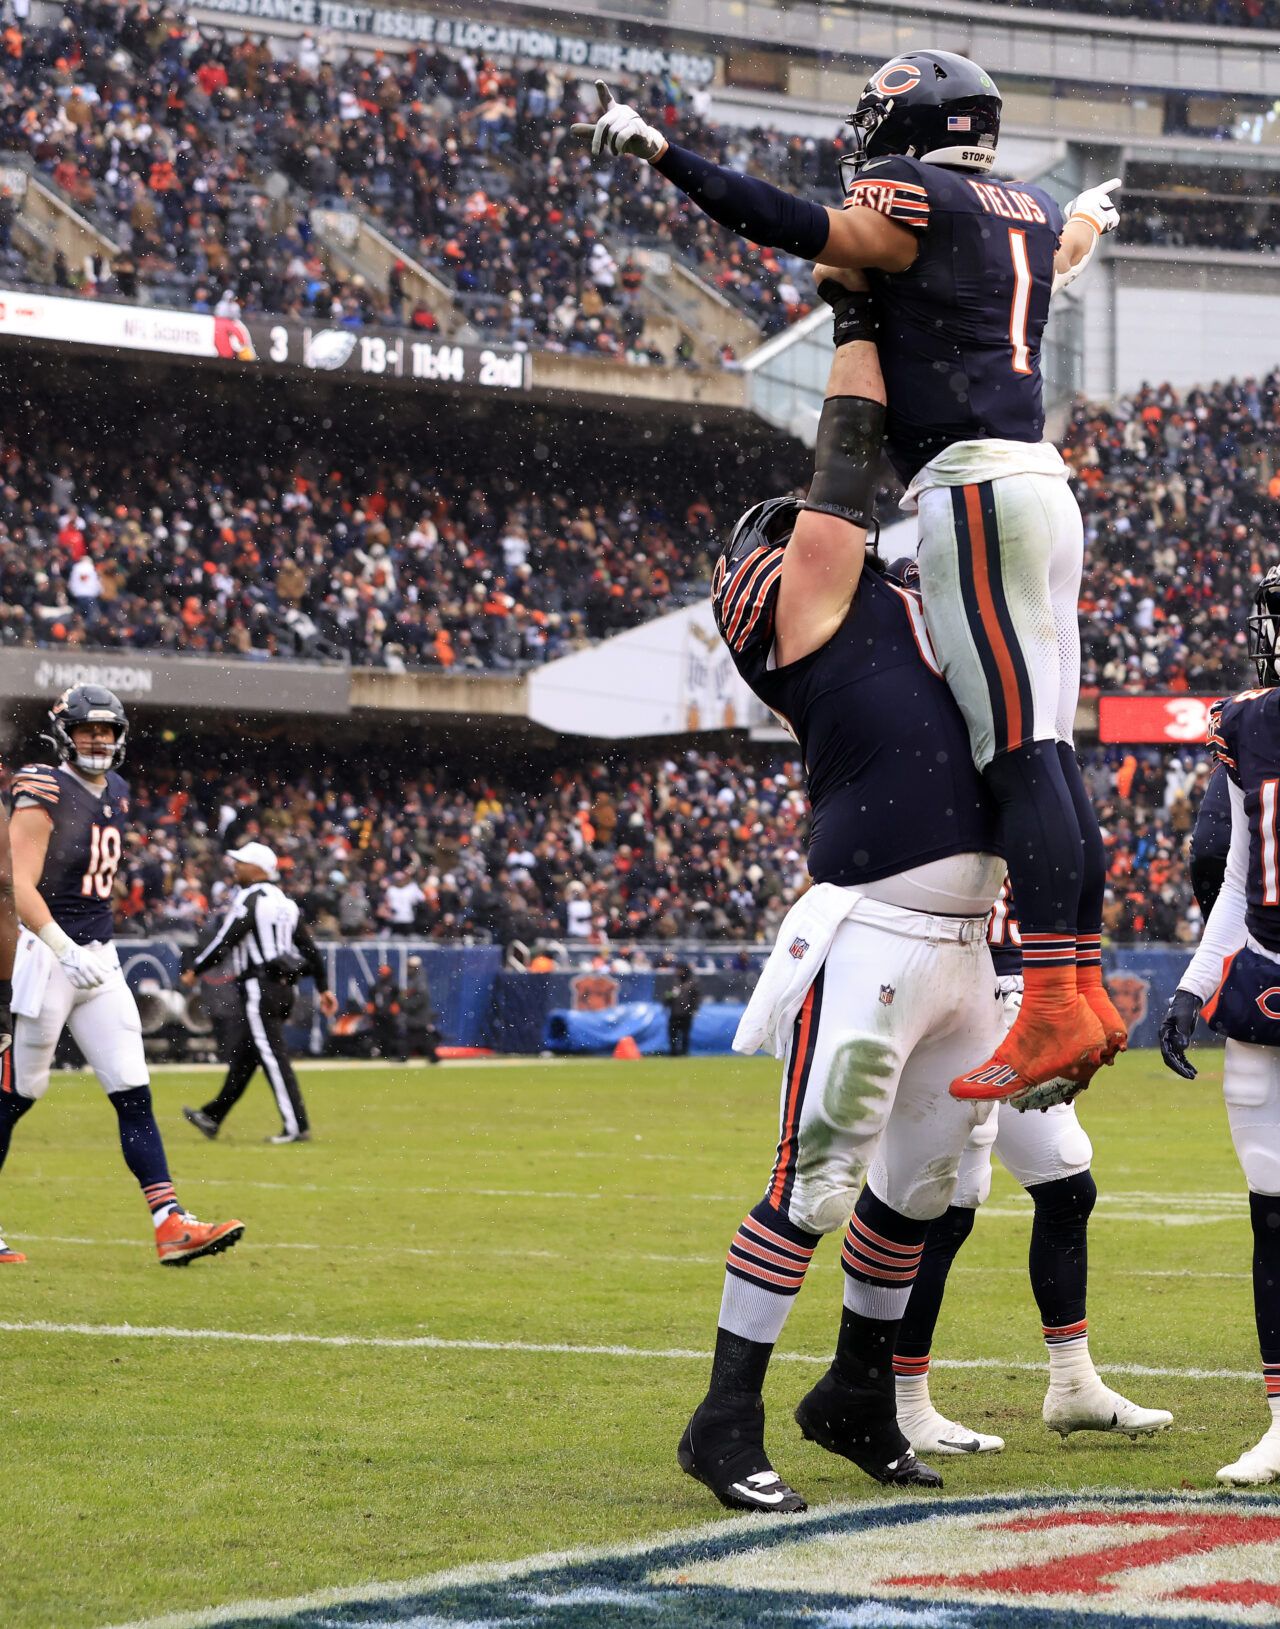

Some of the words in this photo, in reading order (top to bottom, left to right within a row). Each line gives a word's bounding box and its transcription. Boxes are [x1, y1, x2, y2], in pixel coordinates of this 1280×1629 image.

[192, 0, 315, 27] ISTANCE
[321, 4, 373, 33] TEXT
[374, 9, 435, 42] ISSUE
[453, 20, 556, 58] LOCATION
[558, 36, 588, 64] TO
[962, 151, 985, 163] STOP
[852, 186, 898, 217] GSH
[967, 179, 1048, 225] FIELDS
[1008, 227, 1034, 374] 1
[270, 326, 289, 363] 3
[411, 342, 464, 382] 11:44
[479, 350, 523, 388] 2nd
[53, 664, 153, 692] HORIZON
[1164, 697, 1208, 740] 3
[81, 824, 121, 898] 18
